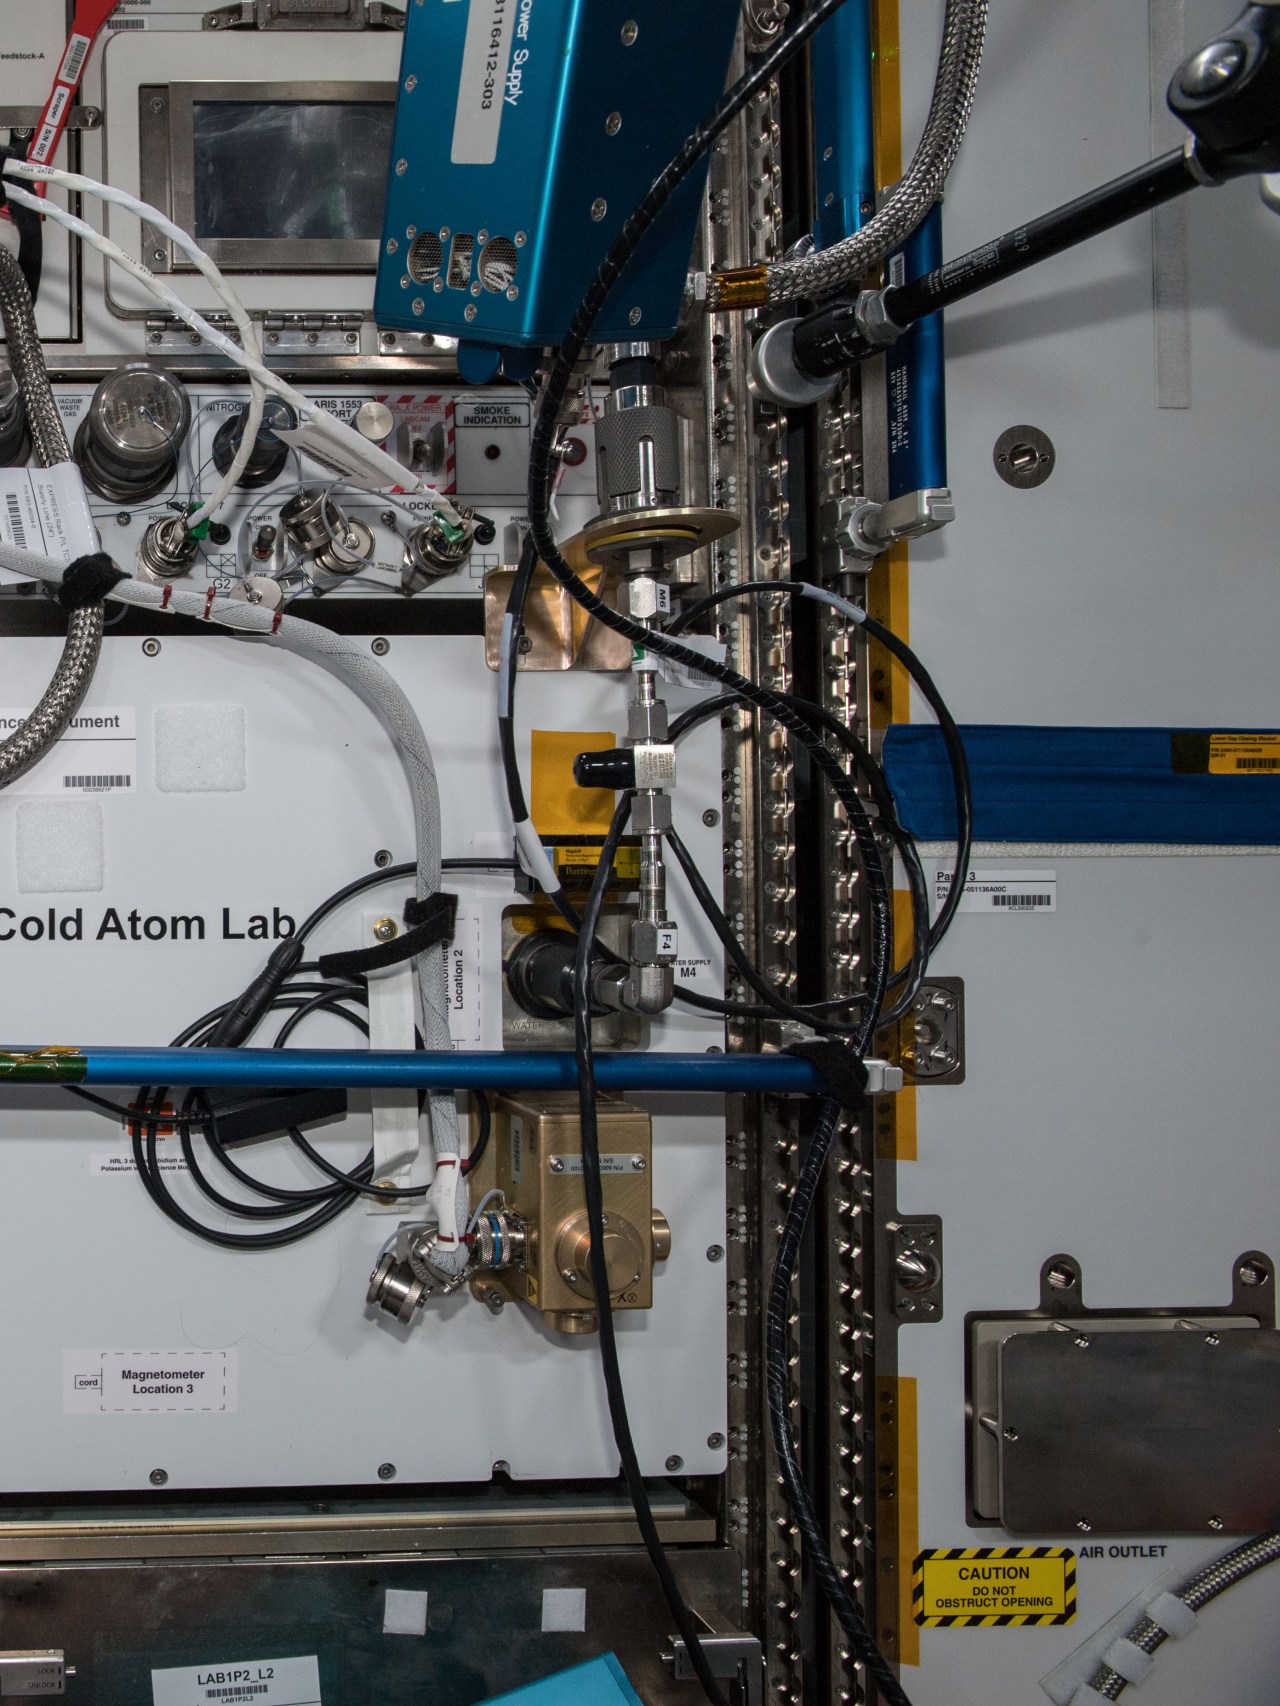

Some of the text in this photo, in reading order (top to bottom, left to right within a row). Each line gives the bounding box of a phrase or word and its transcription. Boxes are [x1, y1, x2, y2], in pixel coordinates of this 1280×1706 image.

[504, 49, 529, 106] Supply
[50, 92, 65, 119] Scraper
[36, 128, 52, 157] S/N 002
[341, 400, 363, 408] 1553
[413, 404, 442, 412] POWER
[473, 406, 511, 415] SMOKE
[463, 416, 522, 425] INDICATION
[38, 484, 46, 506] Supply
[46, 484, 64, 535] EXPRESS Rack
[212, 578, 231, 589] G2
[659, 588, 666, 609] M6
[969, 872, 976, 881] 3
[95, 907, 206, 941] Atom
[222, 907, 296, 940] Lab
[662, 933, 672, 950] F4
[680, 967, 696, 977] M4
[454, 949, 464, 1010] Location 2
[512, 1021, 544, 1029] WATER
[122, 1370, 205, 1381] Magnetometer
[133, 1384, 194, 1394] Location 3
[1079, 1545, 1168, 1558] AIR OUTLET
[958, 1566, 1030, 1581] CAUTION
[972, 1586, 1016, 1596] DO NOT
[935, 1596, 1054, 1608] OBSTRUCT OPENING
[37, 1667, 56, 1675] LOCK
[197, 1667, 274, 1686] LAB1P2_L2
[221, 1696, 254, 1704] LAB1P2L2
